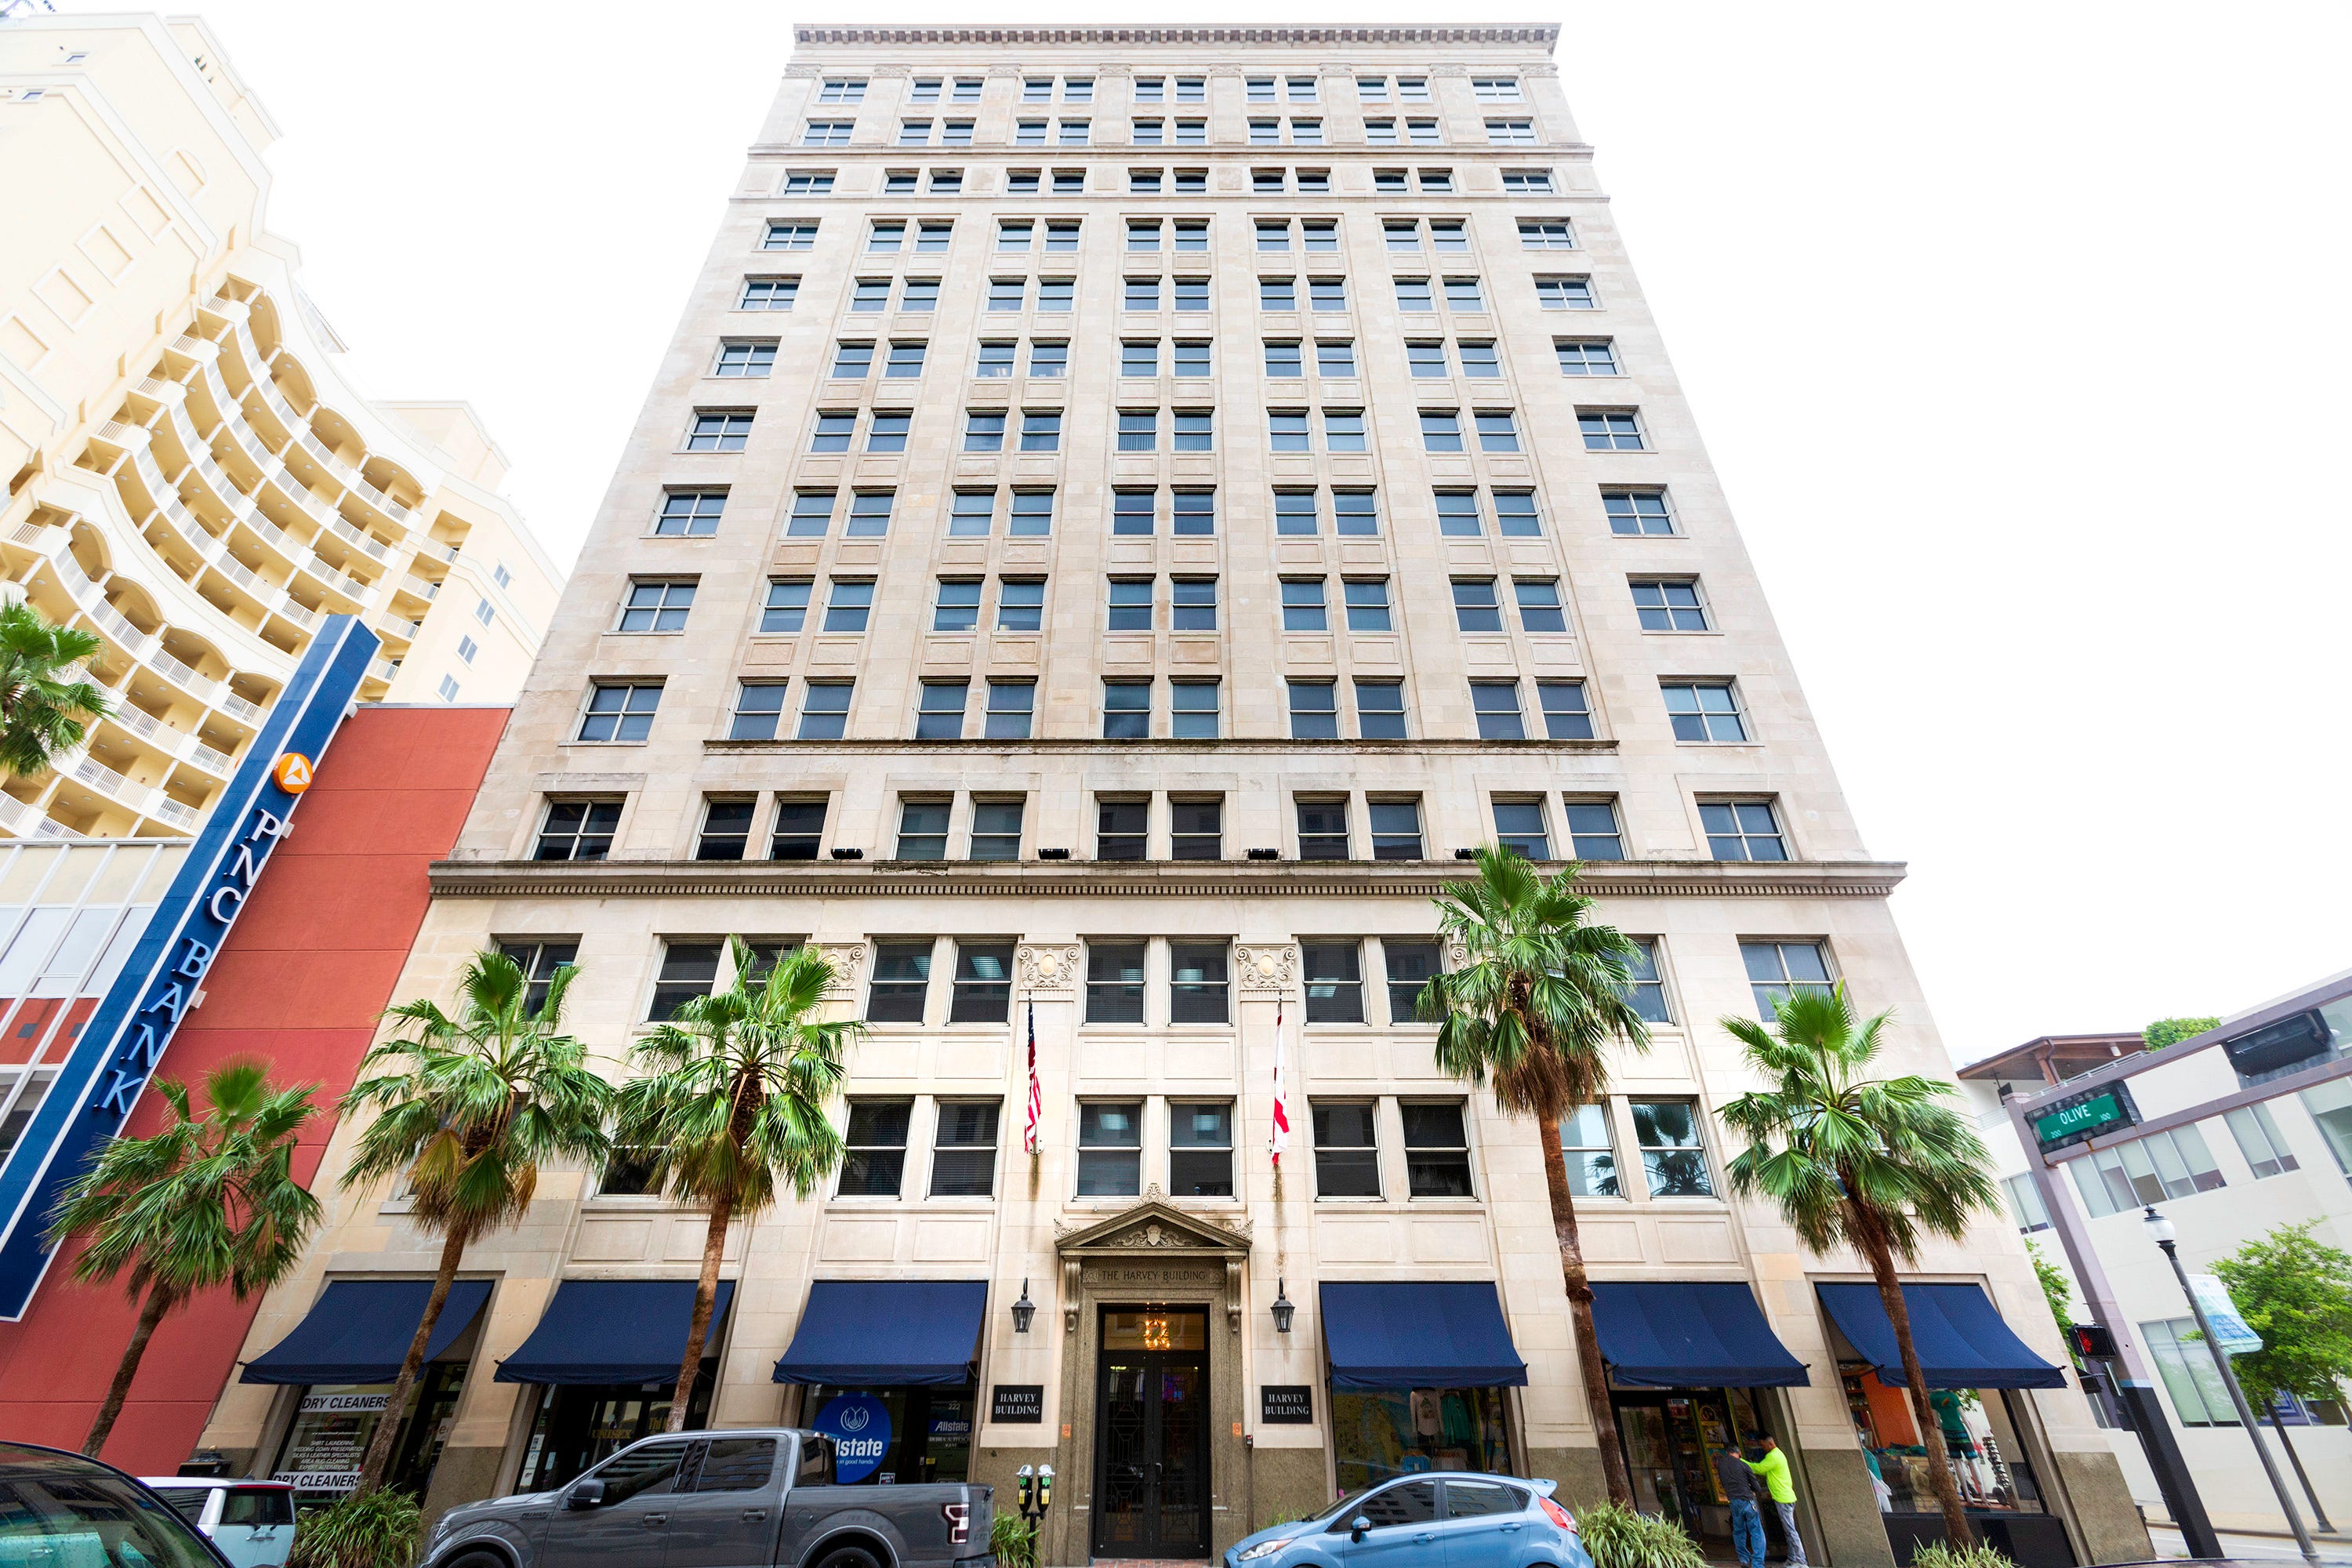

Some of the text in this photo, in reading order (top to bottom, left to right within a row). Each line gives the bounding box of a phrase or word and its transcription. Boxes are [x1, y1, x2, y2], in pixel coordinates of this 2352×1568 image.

[100, 808, 281, 1115] PNC BANK
[2060, 1104, 2092, 1125] OLIVE
[2100, 1112, 2111, 1122] 100
[2050, 1129, 2062, 1138] 200
[1102, 1270, 1207, 1280] THE HARVEY BUILDING
[301, 1396, 390, 1409] DRY CLEANERS
[1000, 1393, 1036, 1403] HARVEY
[1269, 1394, 1305, 1403] HARVEY
[995, 1405, 1040, 1414] BUILDING
[1265, 1406, 1309, 1415] BUILDING
[935, 1421, 969, 1432] Allstate
[833, 1438, 884, 1457] lstate
